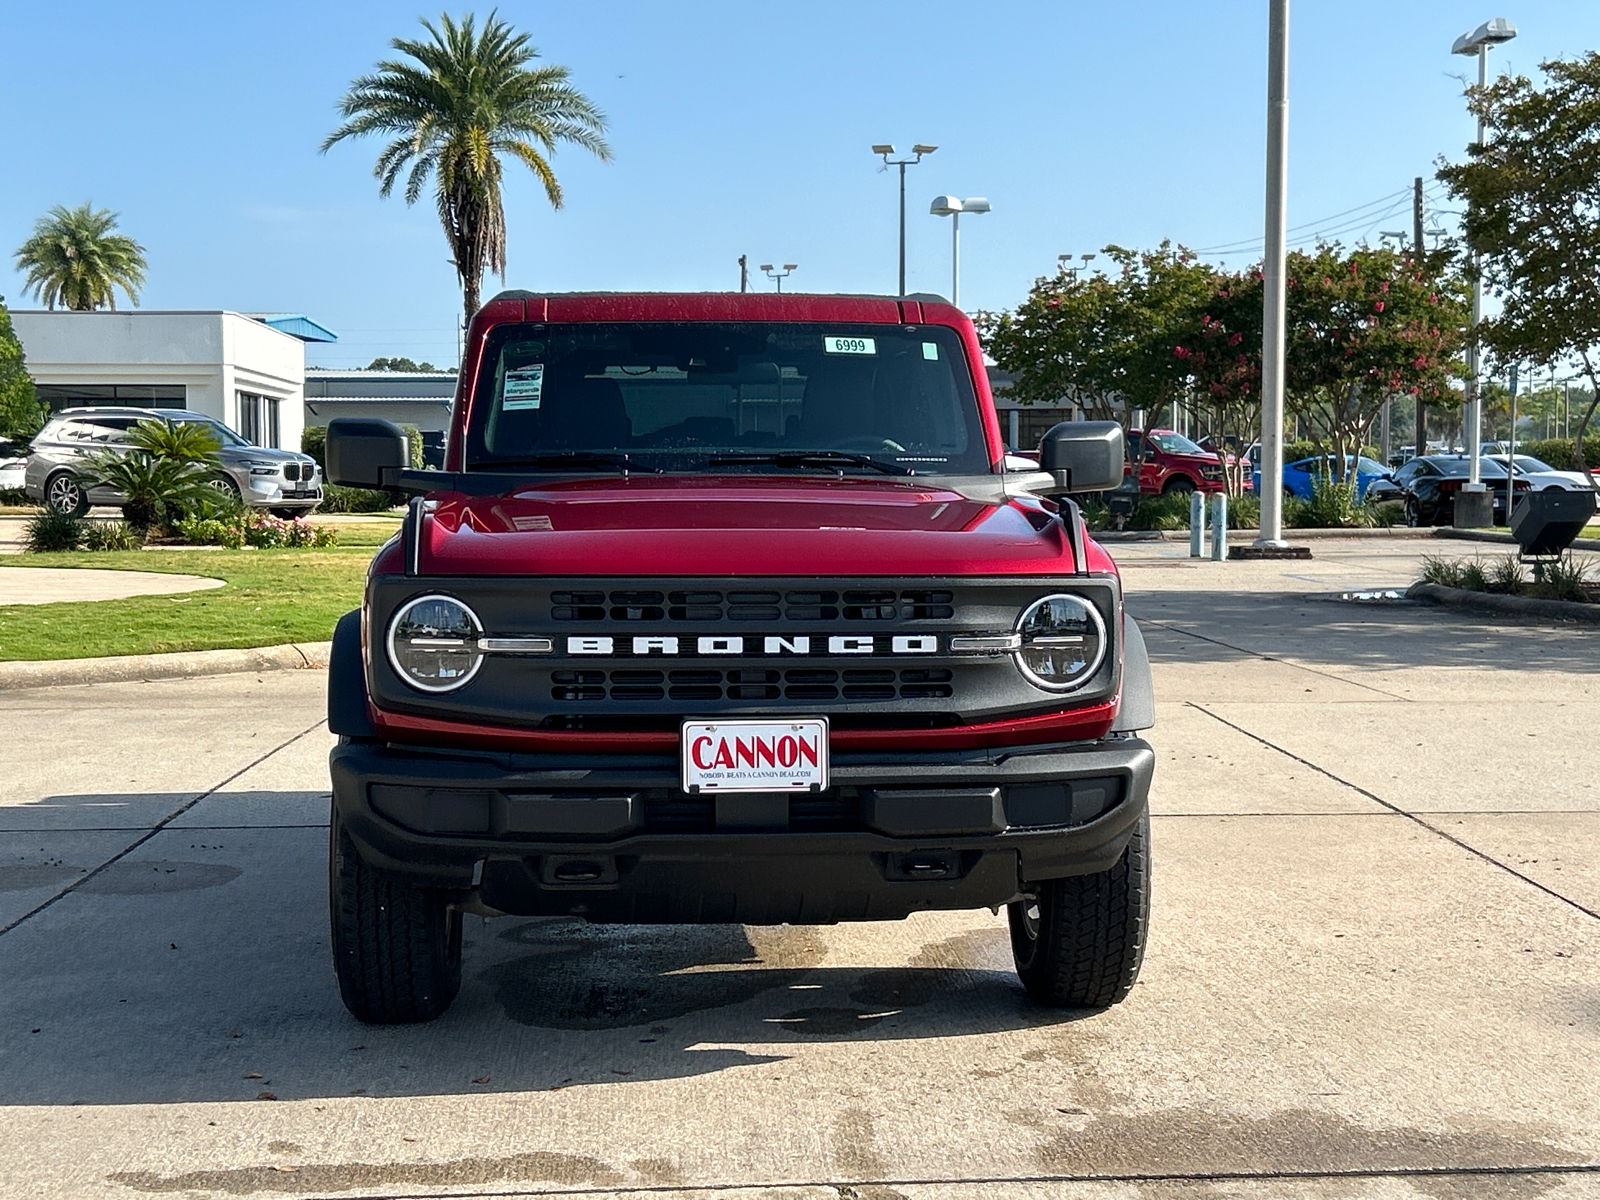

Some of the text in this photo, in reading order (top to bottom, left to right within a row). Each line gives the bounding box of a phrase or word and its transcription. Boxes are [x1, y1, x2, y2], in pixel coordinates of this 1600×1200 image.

[835, 339, 865, 352] 6999
[567, 635, 938, 654] BRONCO
[691, 735, 818, 770] CANNON
[699, 771, 725, 779] NOBODY
[726, 771, 747, 779] BEATS
[780, 770, 811, 778] DEAL.COM
